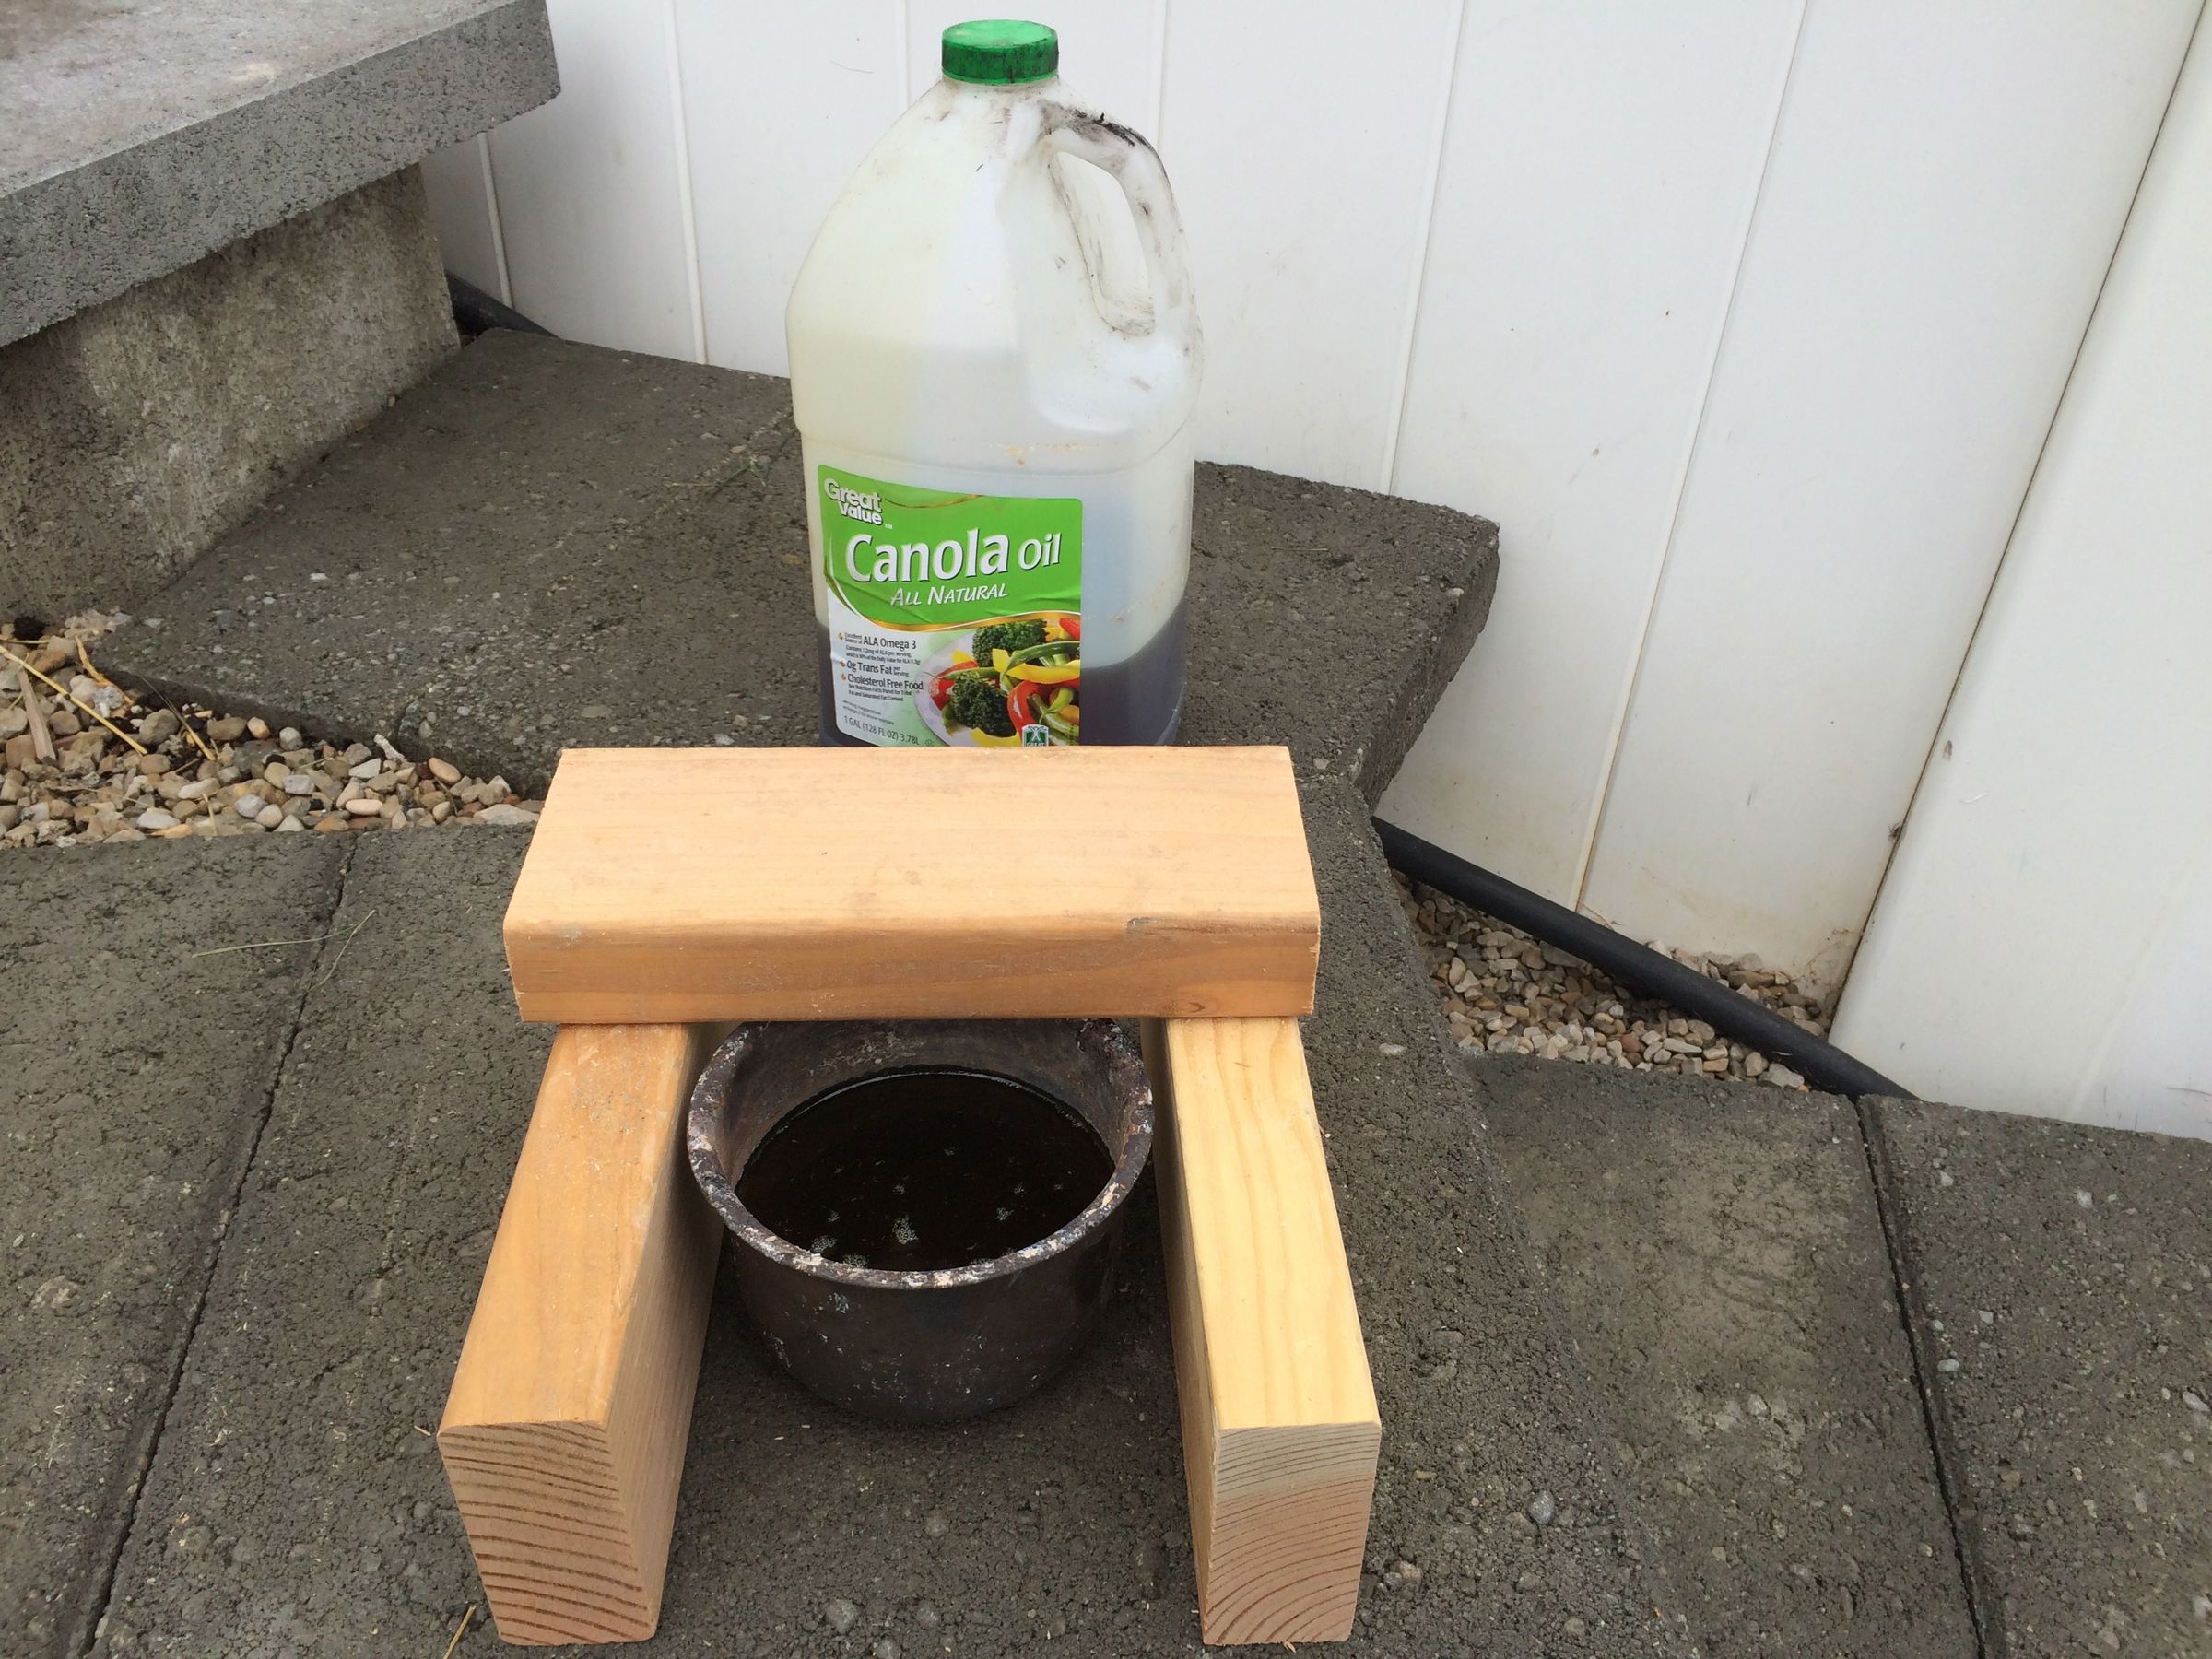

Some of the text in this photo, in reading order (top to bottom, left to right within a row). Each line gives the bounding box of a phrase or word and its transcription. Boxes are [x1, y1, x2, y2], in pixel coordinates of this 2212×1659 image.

[824, 477, 882, 513] Great
[838, 500, 884, 525] Value
[845, 526, 1011, 583] Canola
[890, 582, 1009, 606] ALL NATURAL
[864, 636, 916, 651] ALA Omega 3
[858, 662, 878, 673] Trans
[881, 665, 893, 675] Fat
[848, 674, 924, 689] Cholesterol Free Food
[849, 717, 862, 729] GAL
[863, 722, 877, 731] (128
[878, 726, 885, 737] FL
[900, 733, 920, 745] 3.78L
